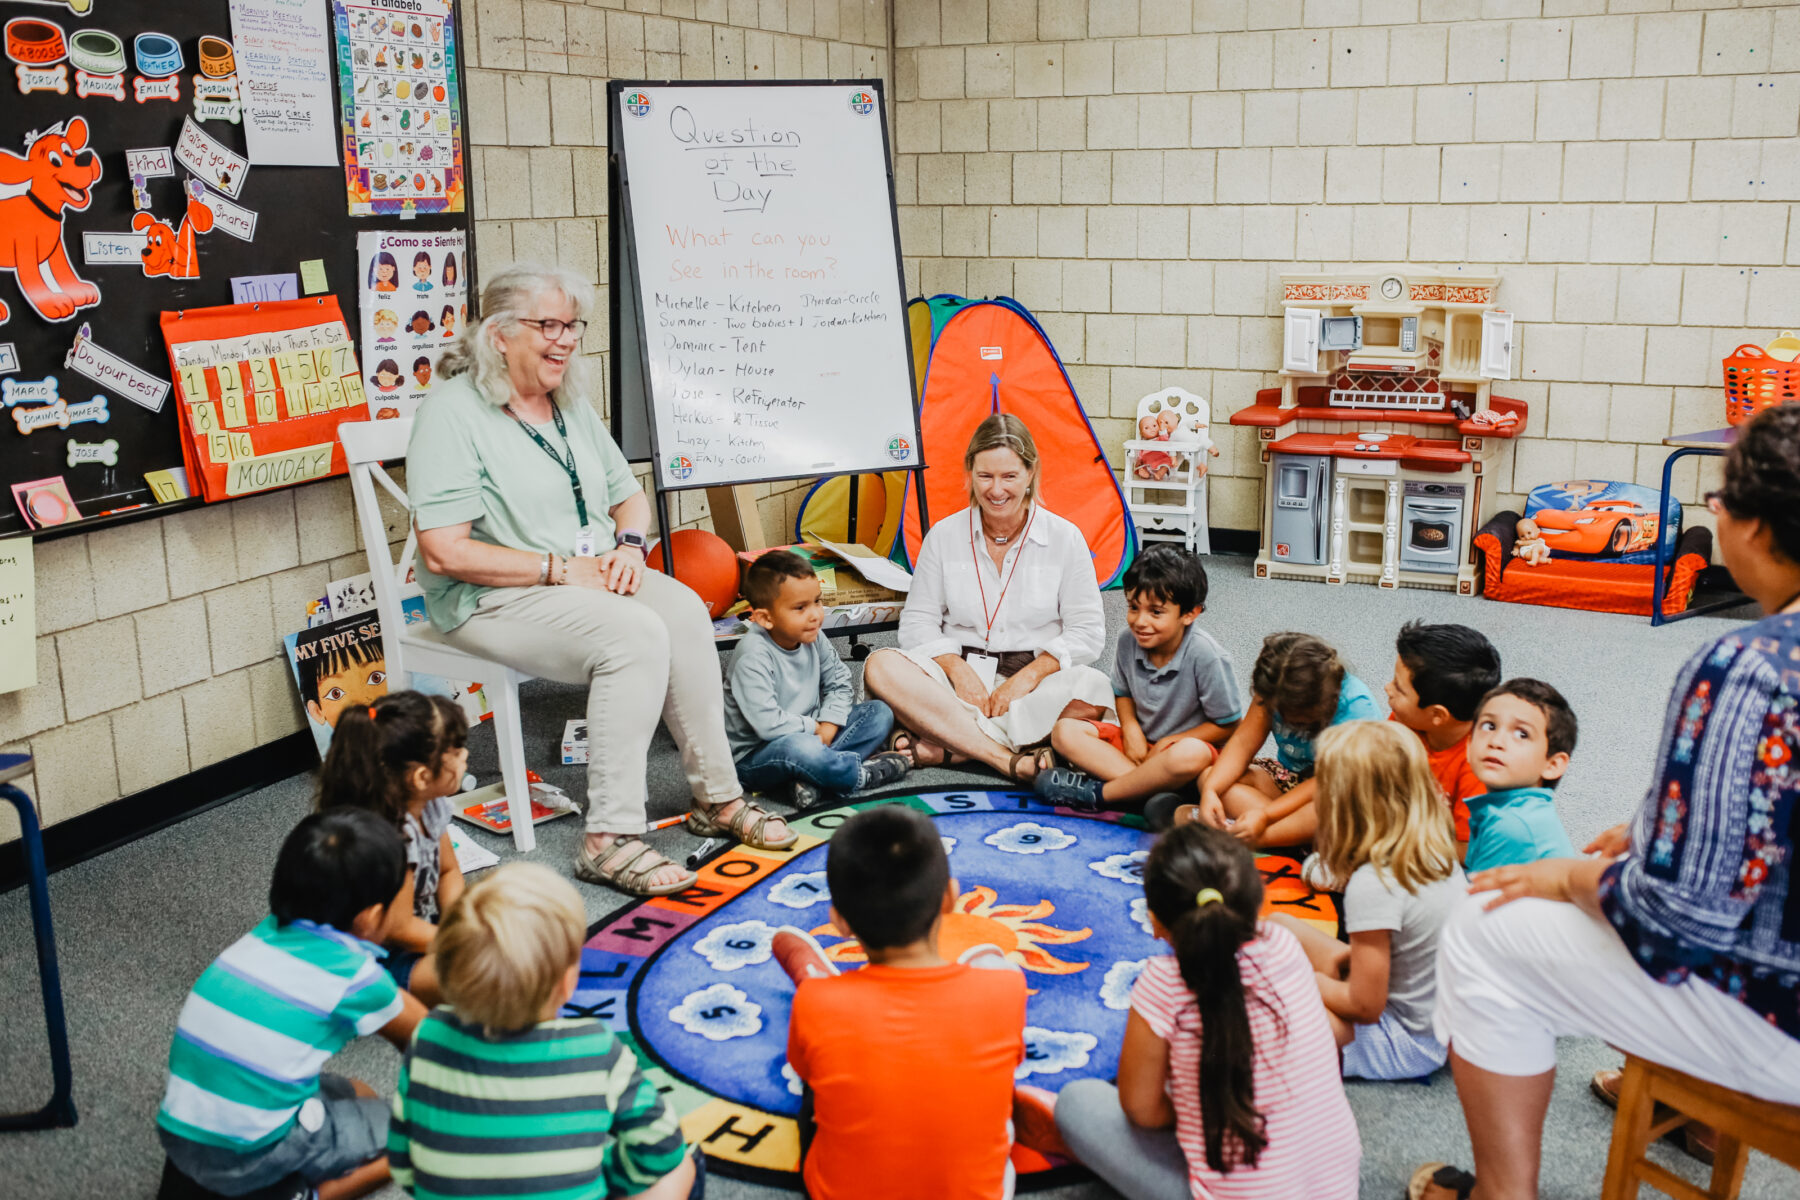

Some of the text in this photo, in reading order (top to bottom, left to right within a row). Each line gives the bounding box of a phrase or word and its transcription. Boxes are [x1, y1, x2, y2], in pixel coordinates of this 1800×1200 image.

[381, 0, 422, 12] alfabeto
[11, 43, 64, 60] CABOOSE
[138, 59, 176, 72] WEATHER
[200, 60, 232, 74] TABLES
[82, 79, 119, 91] MADISON
[139, 83, 170, 94] EMILY
[201, 105, 234, 116] LINZY
[670, 105, 801, 145] Question
[185, 125, 209, 153] Raise
[136, 152, 167, 171] kind
[704, 152, 796, 172] of the
[714, 180, 772, 213] Day
[215, 204, 249, 230] Share
[88, 241, 132, 256] Listen
[421, 237, 433, 247] se
[435, 236, 456, 247] Siente
[666, 224, 831, 256] What can you
[669, 256, 838, 282] See in the room?
[240, 280, 287, 302] JULY
[655, 292, 710, 310] Michelle
[729, 293, 781, 313] Kitchen
[659, 312, 706, 328] Summer
[723, 317, 746, 329] Two
[178, 356, 210, 368] Sunday
[211, 345, 244, 361] Monday
[263, 339, 282, 355] Wed
[284, 334, 308, 350] Thurs
[324, 327, 343, 343] Sat
[374, 344, 398, 352] afligido
[663, 332, 716, 353] Dominic
[731, 336, 767, 353] Tent
[78, 345, 162, 398] Do your best
[186, 347, 348, 395] 1 2 3 4 5 6 7
[667, 354, 714, 378] Dylan
[735, 362, 775, 377] House
[12, 387, 48, 396] MARIO
[375, 394, 400, 402] culpable
[68, 406, 100, 417] UMMER
[197, 381, 361, 430] 8 9 10 11 12 13 14
[24, 411, 60, 424] DOMINIC
[745, 412, 780, 429] Tissue
[75, 448, 98, 457] JOSE
[210, 434, 250, 457] 15 16
[696, 452, 725, 467] Emily
[237, 452, 326, 490] MONDAY
[157, 482, 178, 500] 17
[294, 640, 318, 663] MY
[320, 629, 359, 654] FIVE
[943, 794, 977, 809] S
[1019, 834, 1042, 845] 9
[714, 859, 760, 878] O
[1258, 864, 1301, 885] X
[667, 886, 724, 907] N
[794, 882, 820, 894] 7
[1270, 894, 1322, 912] Y
[611, 916, 676, 942] M
[725, 939, 757, 950] 6
[578, 962, 630, 978] L
[561, 997, 617, 1019] K
[699, 1005, 737, 1020] 5
[704, 1115, 776, 1154] H
